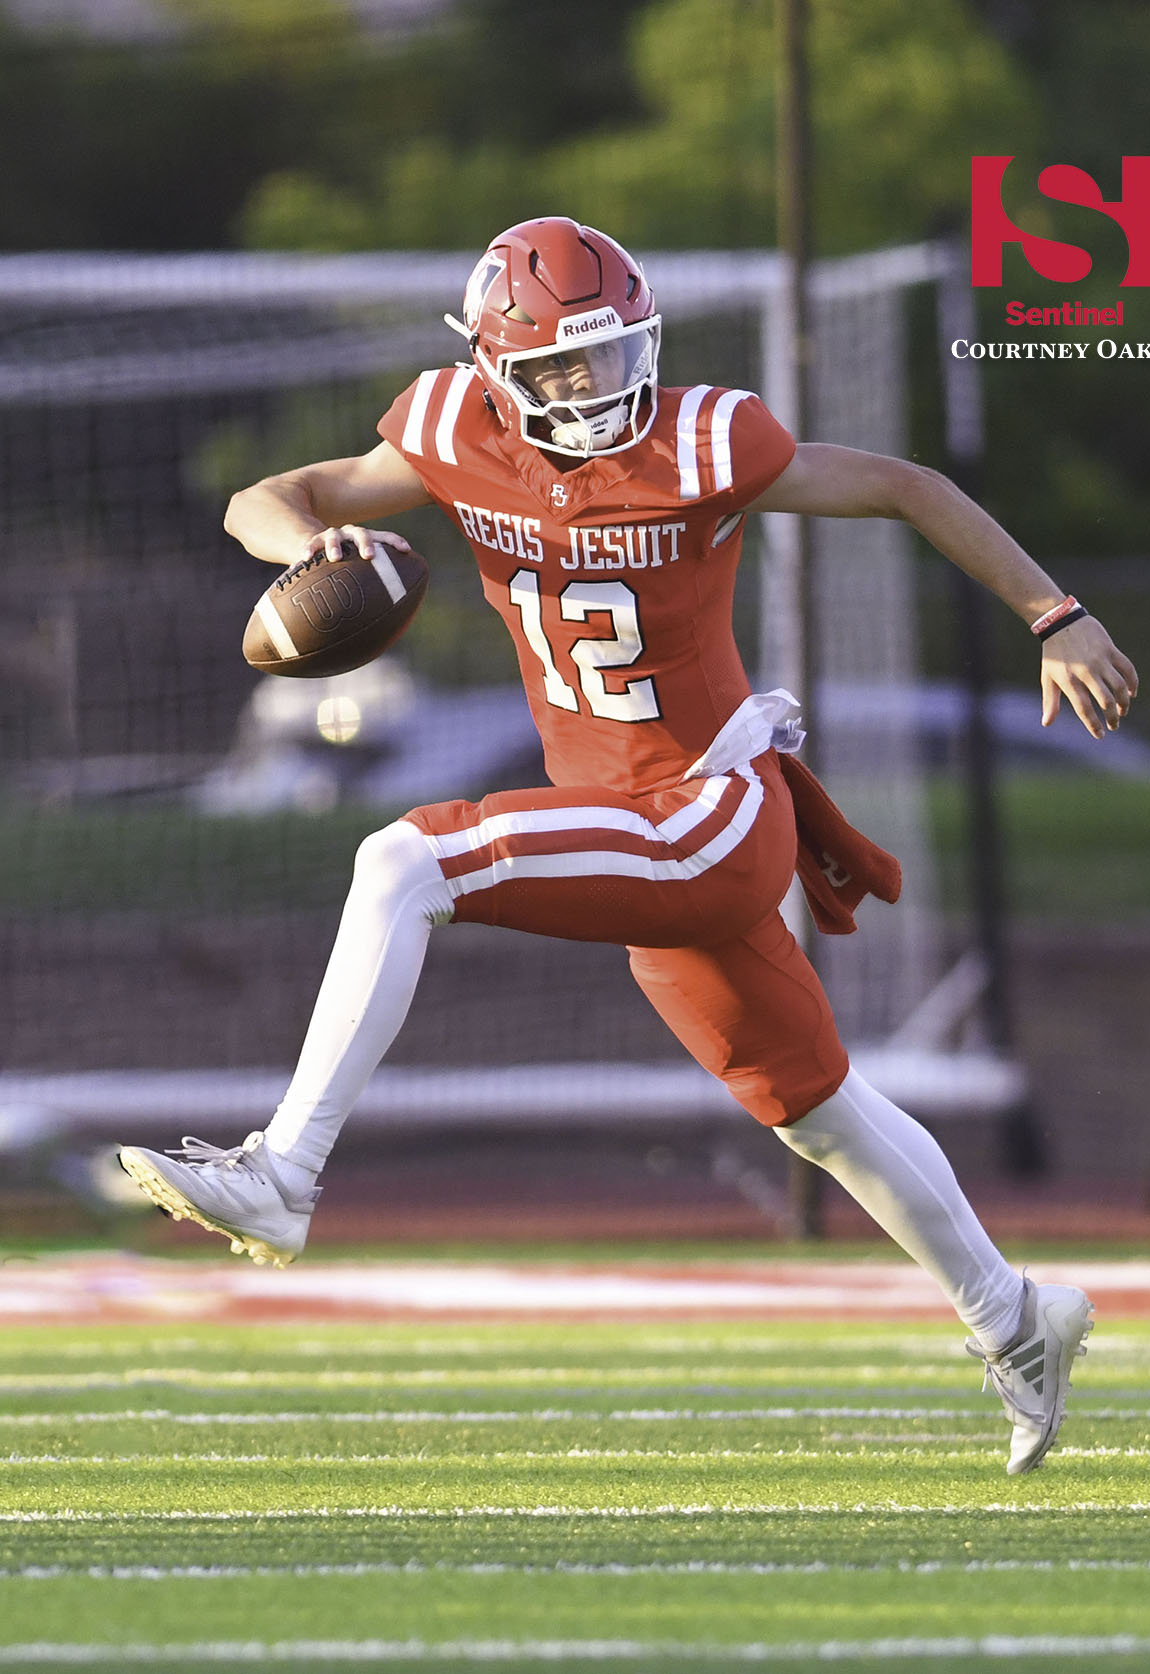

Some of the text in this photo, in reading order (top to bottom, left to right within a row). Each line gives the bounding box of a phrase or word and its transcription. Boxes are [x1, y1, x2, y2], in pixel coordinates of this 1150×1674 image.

[563, 313, 616, 337] Riddell
[453, 501, 687, 570] REGIS JESUIT
[509, 567, 664, 723] 12
